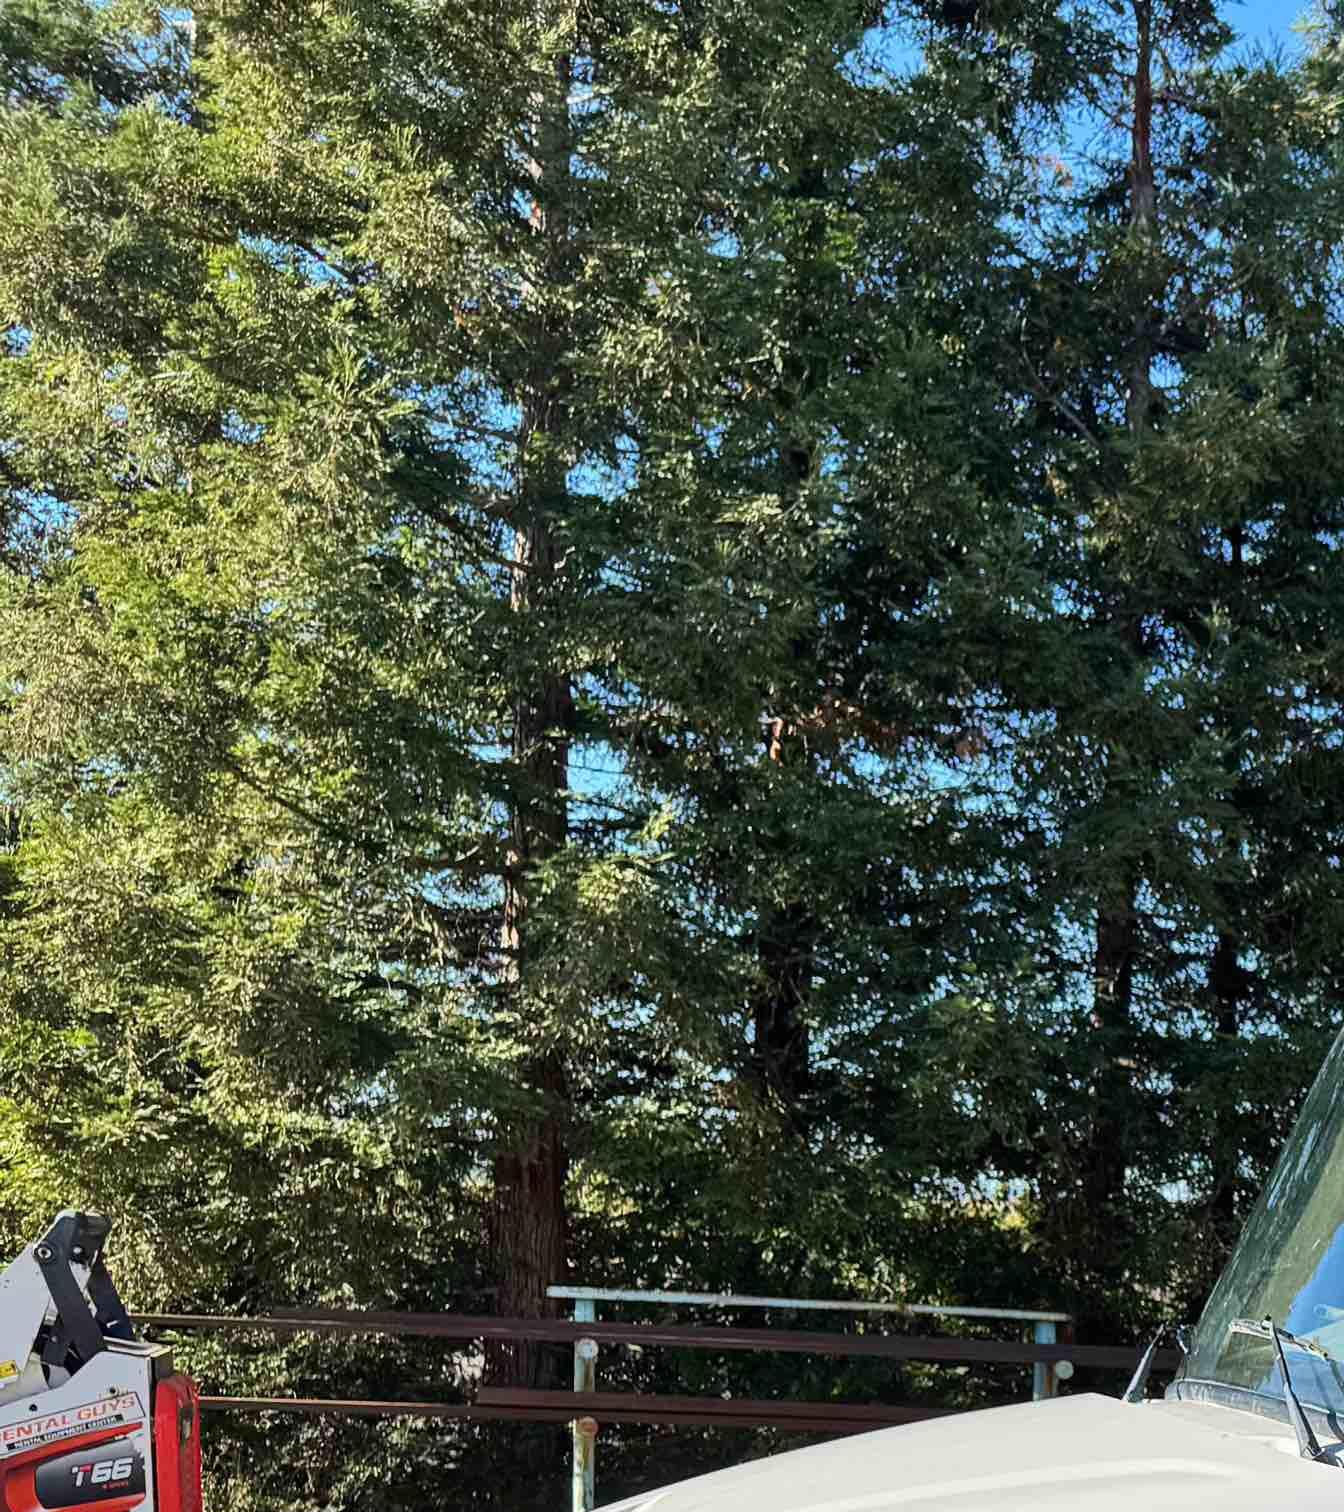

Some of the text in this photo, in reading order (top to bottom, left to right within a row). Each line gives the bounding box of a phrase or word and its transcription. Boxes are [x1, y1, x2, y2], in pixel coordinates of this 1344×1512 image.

[0, 1397, 135, 1442] ENTAL GUYS
[72, 1457, 133, 1487] T66
